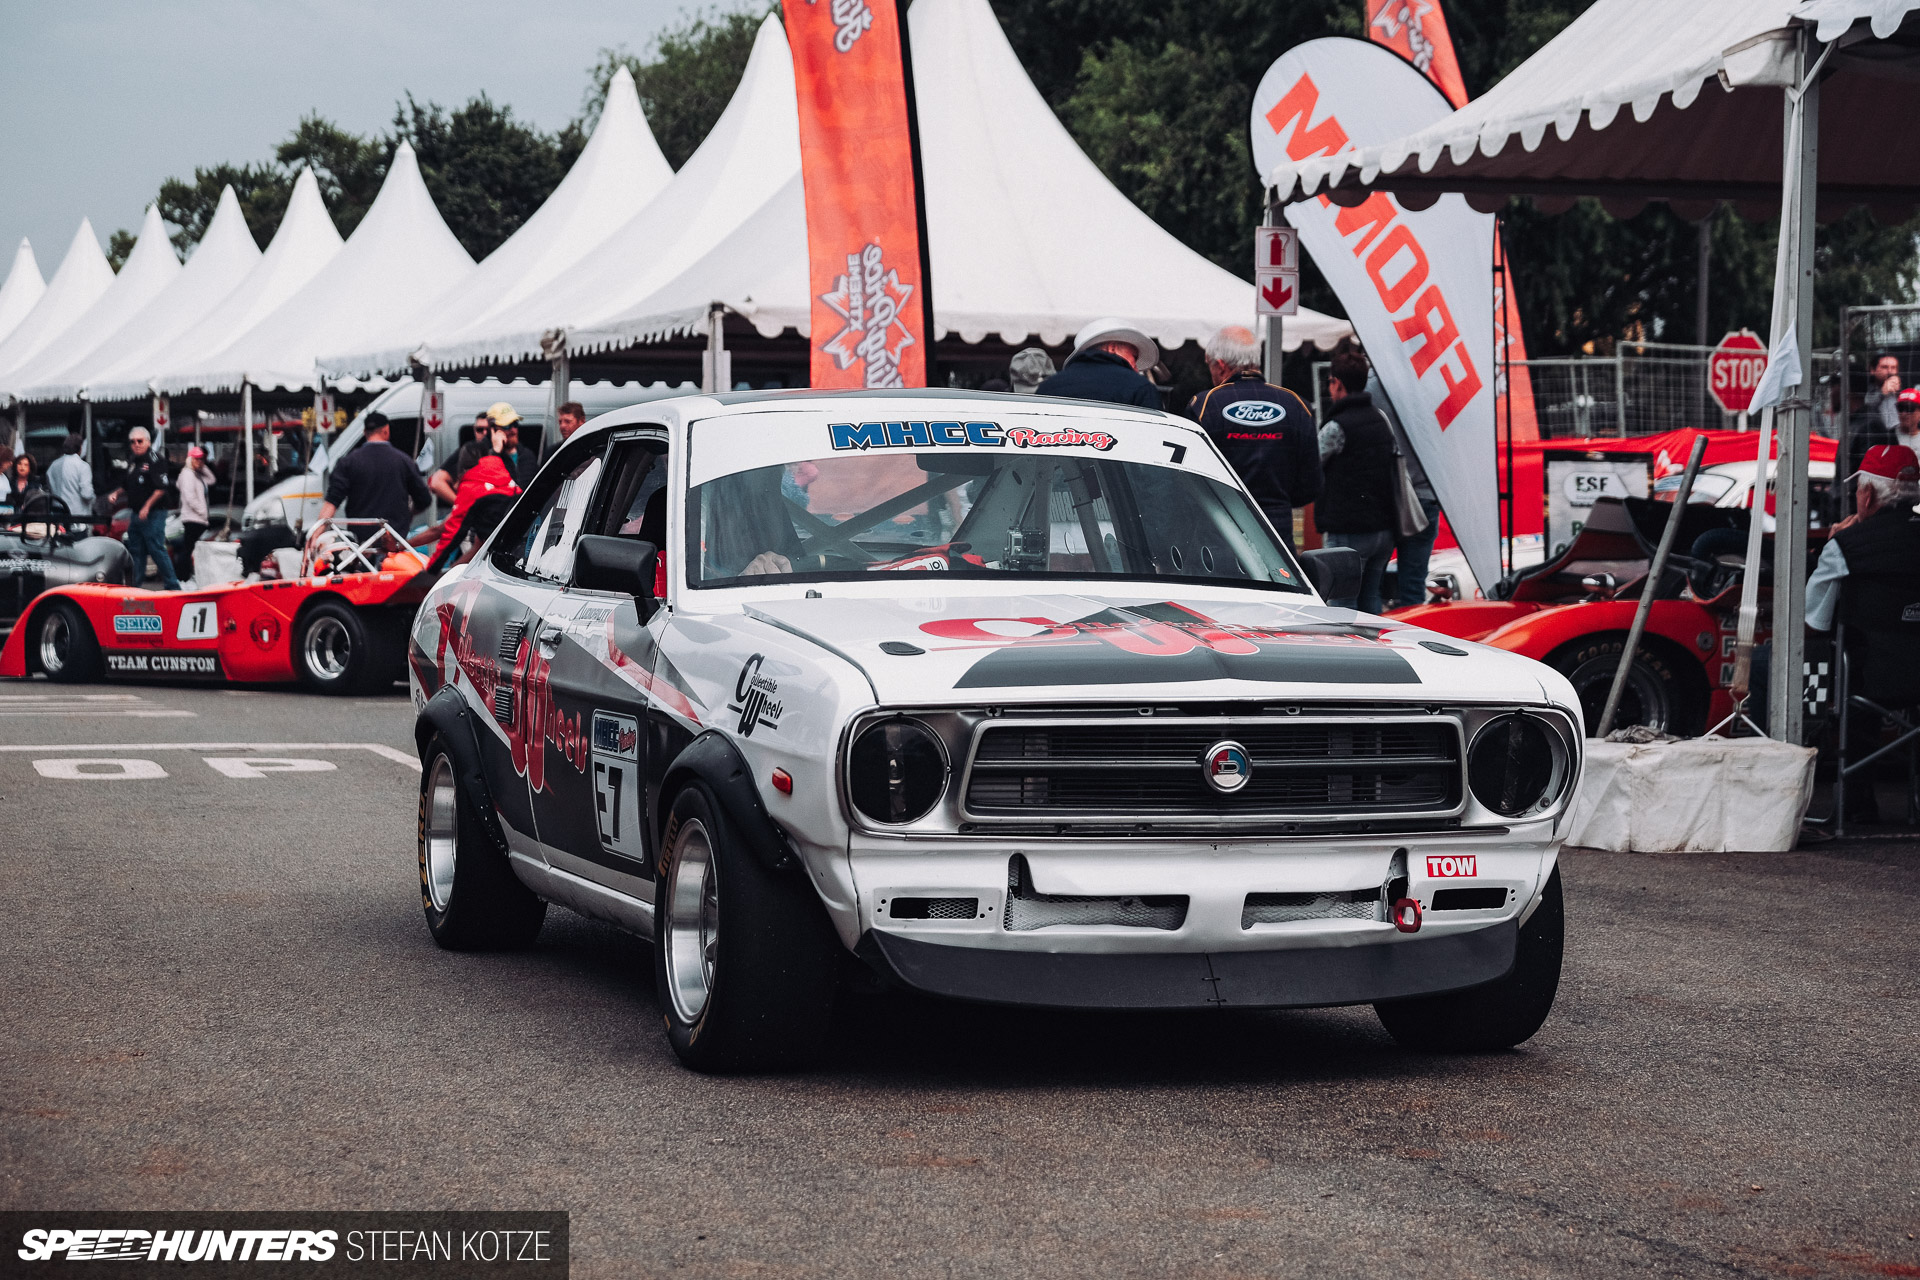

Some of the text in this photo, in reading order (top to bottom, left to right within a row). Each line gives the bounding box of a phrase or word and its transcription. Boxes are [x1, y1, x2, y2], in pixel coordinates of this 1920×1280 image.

[1715, 358, 1765, 390] STOP
[1235, 403, 1275, 420] Ford
[829, 421, 1118, 452] MHCC Racing
[1226, 432, 1284, 440] RACING
[1161, 440, 1188, 464] 7
[116, 616, 161, 631] SEIKO
[108, 655, 149, 670] TEAM
[735, 652, 778, 704] Collectible
[737, 688, 783, 738] Wheels
[1427, 857, 1475, 877] TOW
